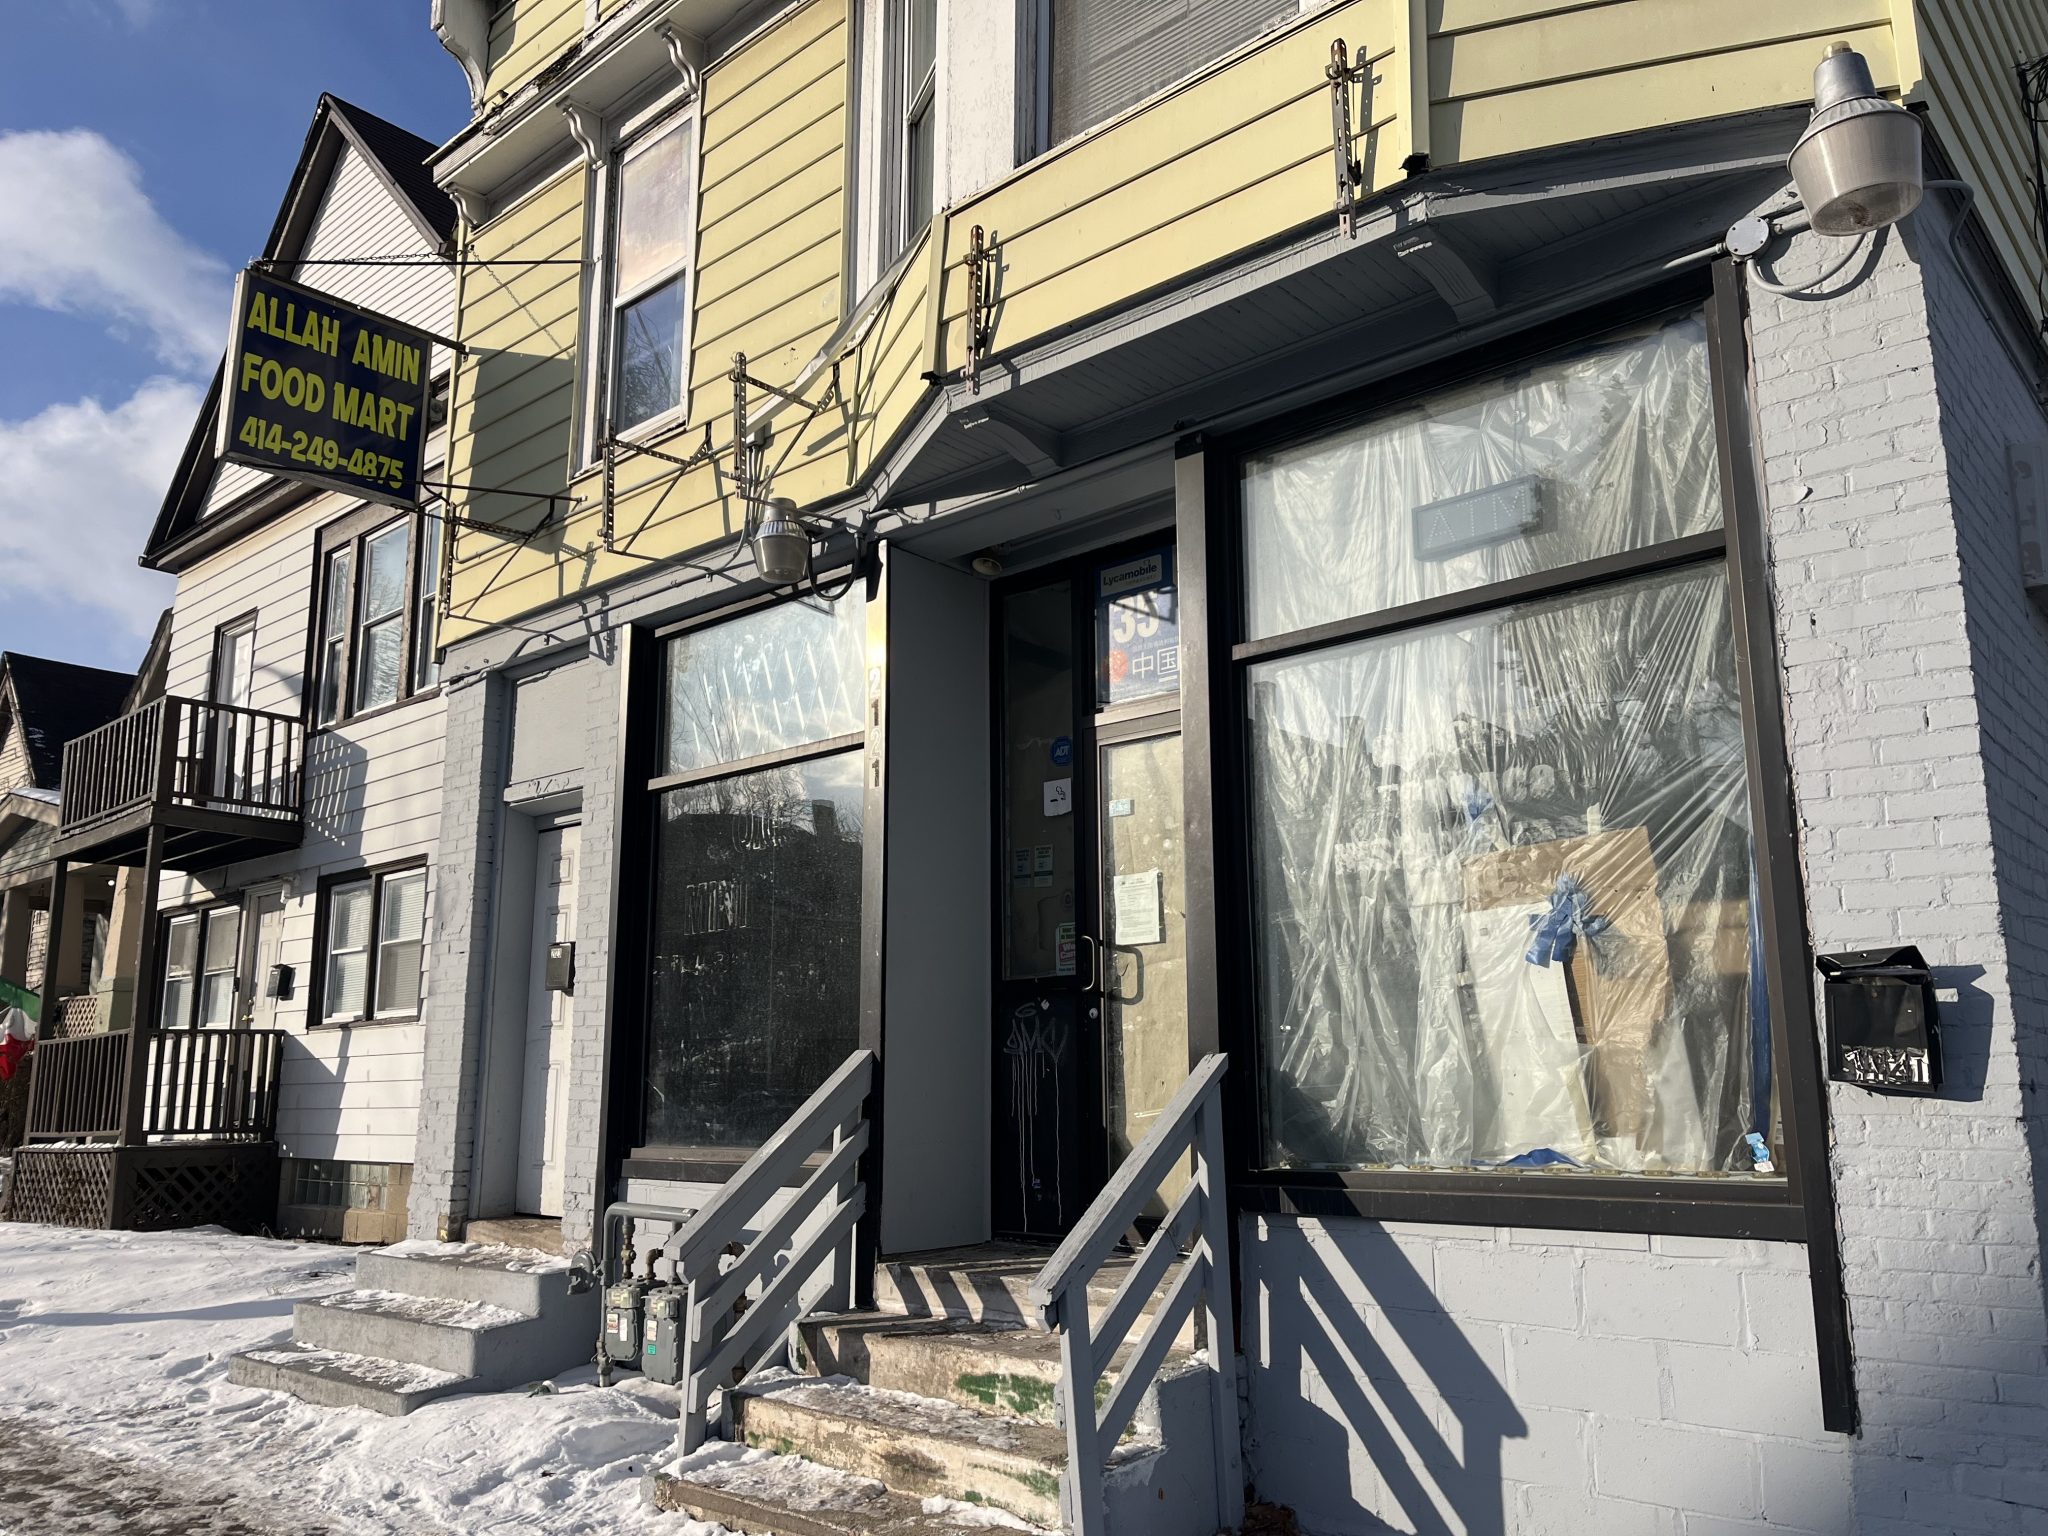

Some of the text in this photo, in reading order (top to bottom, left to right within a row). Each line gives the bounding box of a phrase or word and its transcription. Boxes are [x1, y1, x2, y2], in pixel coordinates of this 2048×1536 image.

[247, 292, 420, 385] ALLAH AMIN
[241, 352, 415, 441] FOOD MART
[239, 416, 404, 489] 414-249-4875
[1424, 485, 1526, 548] ATM
[1103, 564, 1157, 586] Lycamobile
[1113, 590, 1160, 643] 35
[1132, 646, 1180, 679] 中国
[868, 667, 881, 788] 2121
[1054, 745, 1070, 757] ADT
